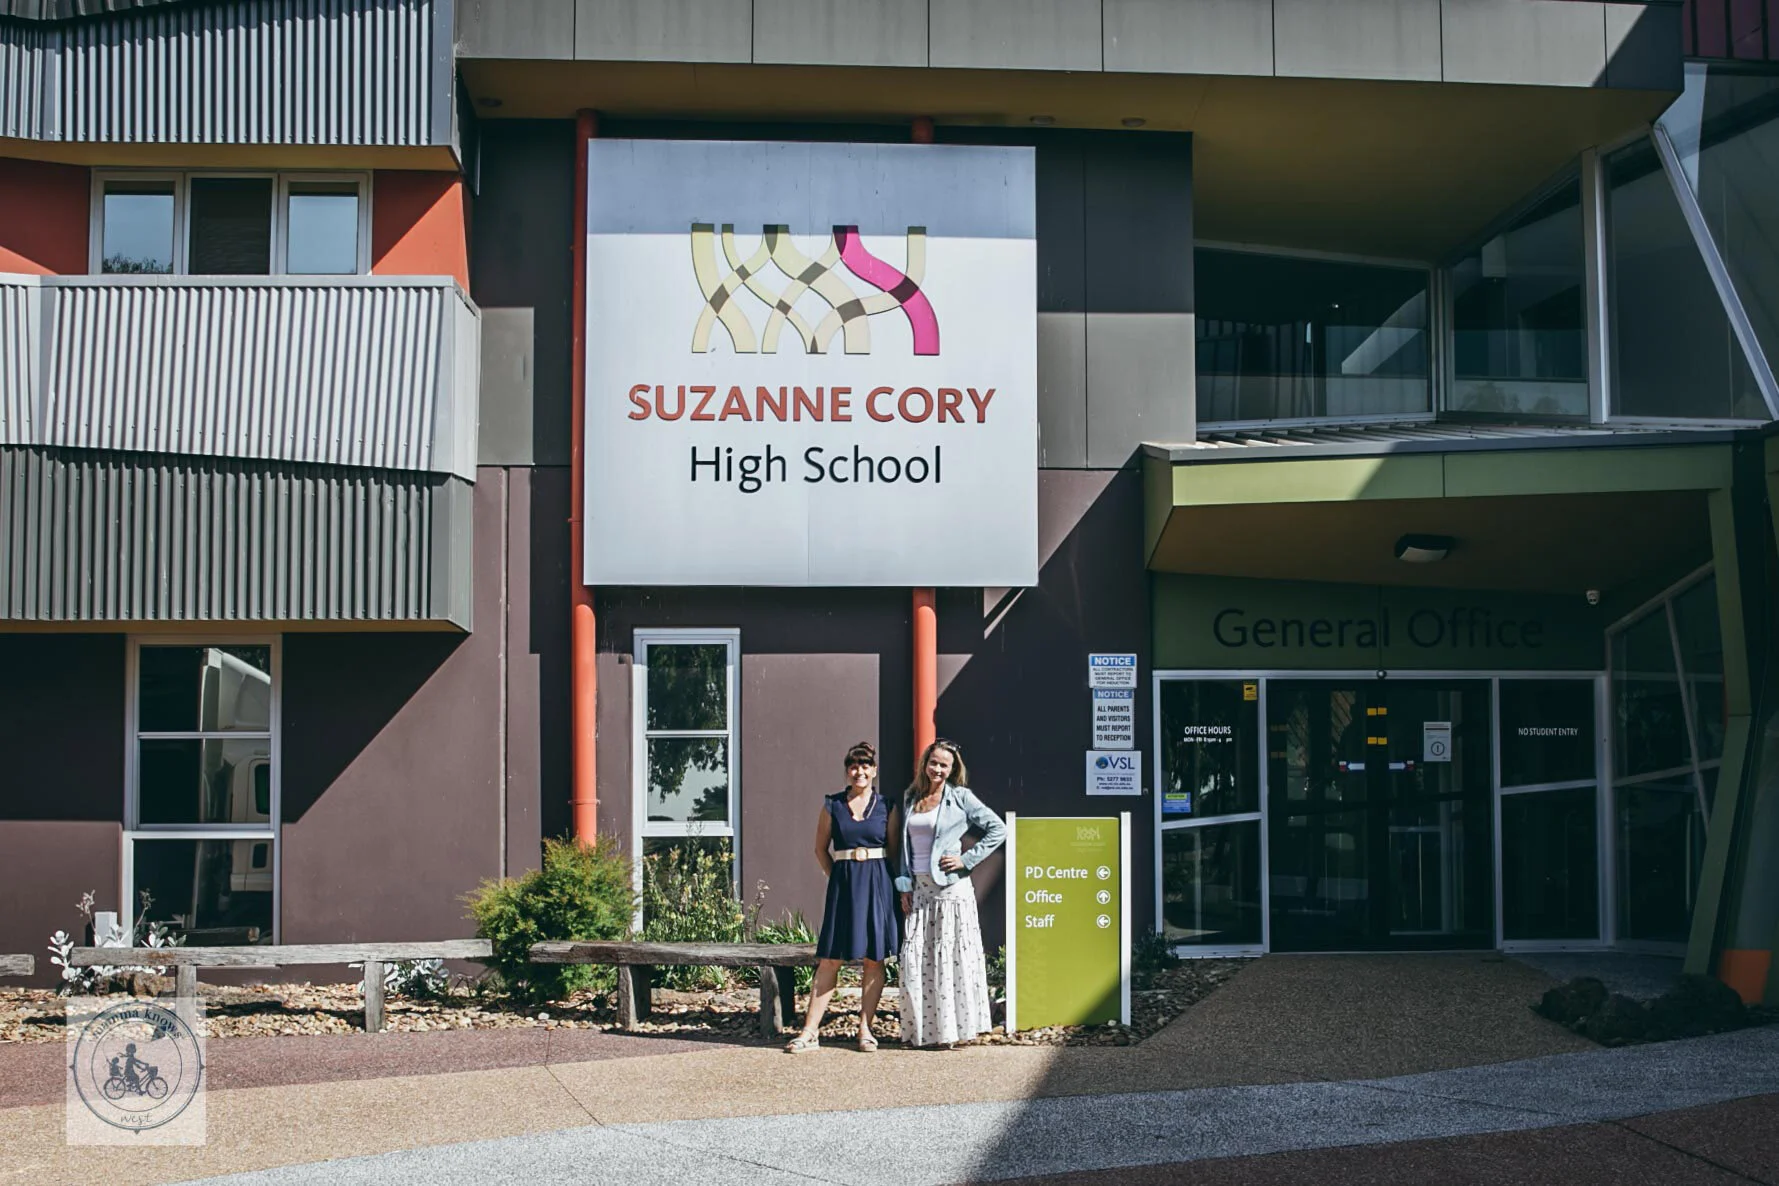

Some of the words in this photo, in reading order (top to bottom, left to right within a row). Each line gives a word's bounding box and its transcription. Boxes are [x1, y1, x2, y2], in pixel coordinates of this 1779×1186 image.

[628, 384, 852, 422] SUZANNE
[866, 386, 996, 424] CORY
[690, 445, 786, 493] High
[803, 445, 941, 484] School
[1213, 607, 1389, 648] General
[1408, 605, 1543, 648] Office
[1094, 657, 1131, 666] NOTICE
[1184, 726, 1206, 734] OFFICE
[1208, 726, 1231, 734] HOURS
[1518, 728, 1528, 736] NO
[1530, 728, 1557, 736] STUDENT
[1559, 728, 1578, 736] ENTRY
[1109, 757, 1135, 769] VSL
[1025, 866, 1043, 879] PD
[1046, 866, 1088, 879] Centre
[1025, 890, 1062, 903] Office
[1025, 915, 1055, 928] Staff
